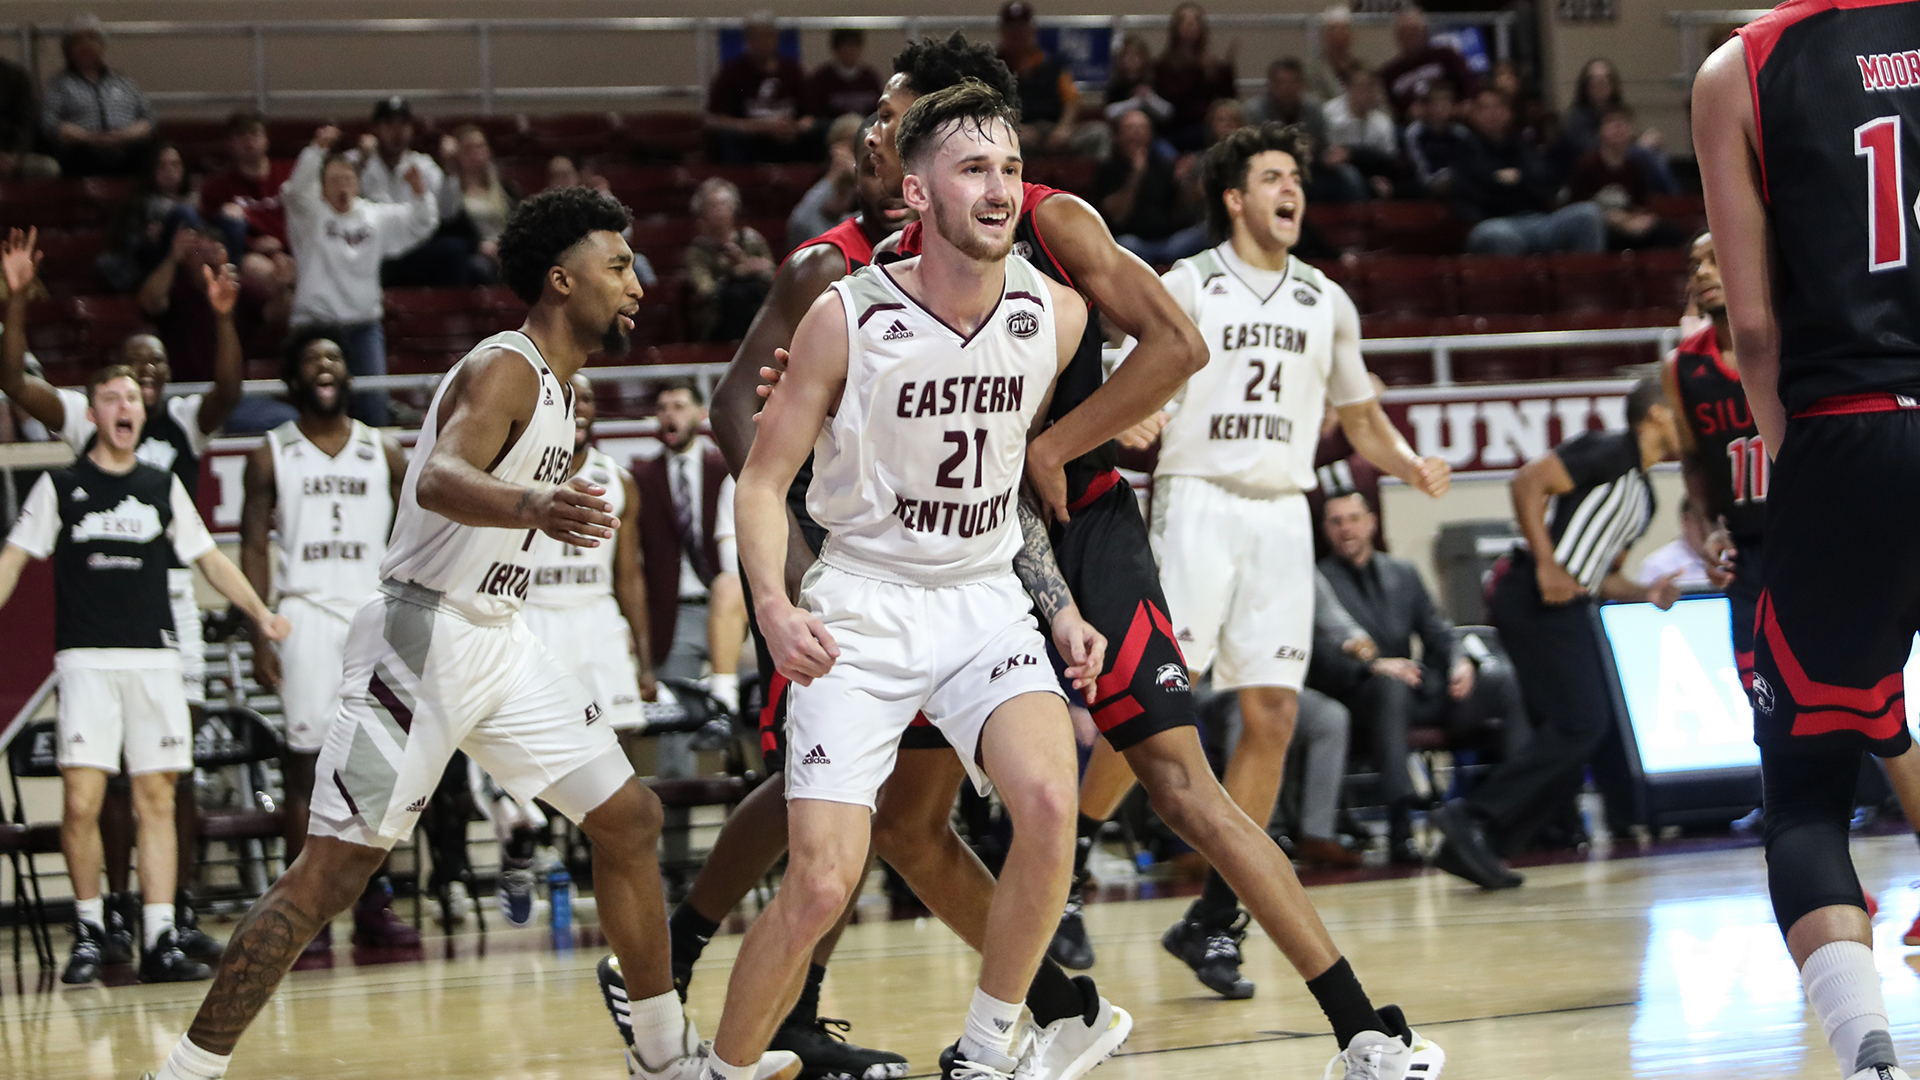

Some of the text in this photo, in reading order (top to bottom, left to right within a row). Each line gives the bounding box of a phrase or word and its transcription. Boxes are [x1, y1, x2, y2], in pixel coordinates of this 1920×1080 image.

[1854, 115, 1920, 273] 1
[883, 330, 914, 341] adidas
[1223, 323, 1307, 354] EASTERN
[897, 375, 1025, 418] EASTERN
[1244, 359, 1282, 402] 24
[1695, 398, 1755, 435] SIU
[935, 427, 988, 489] 21
[1726, 434, 1770, 505] 11
[103, 517, 142, 533] EKU
[892, 486, 1013, 538] KENTUCKY
[989, 653, 1037, 682] EKU
[1274, 645, 1306, 660] EKU
[802, 756, 831, 765] adidas
